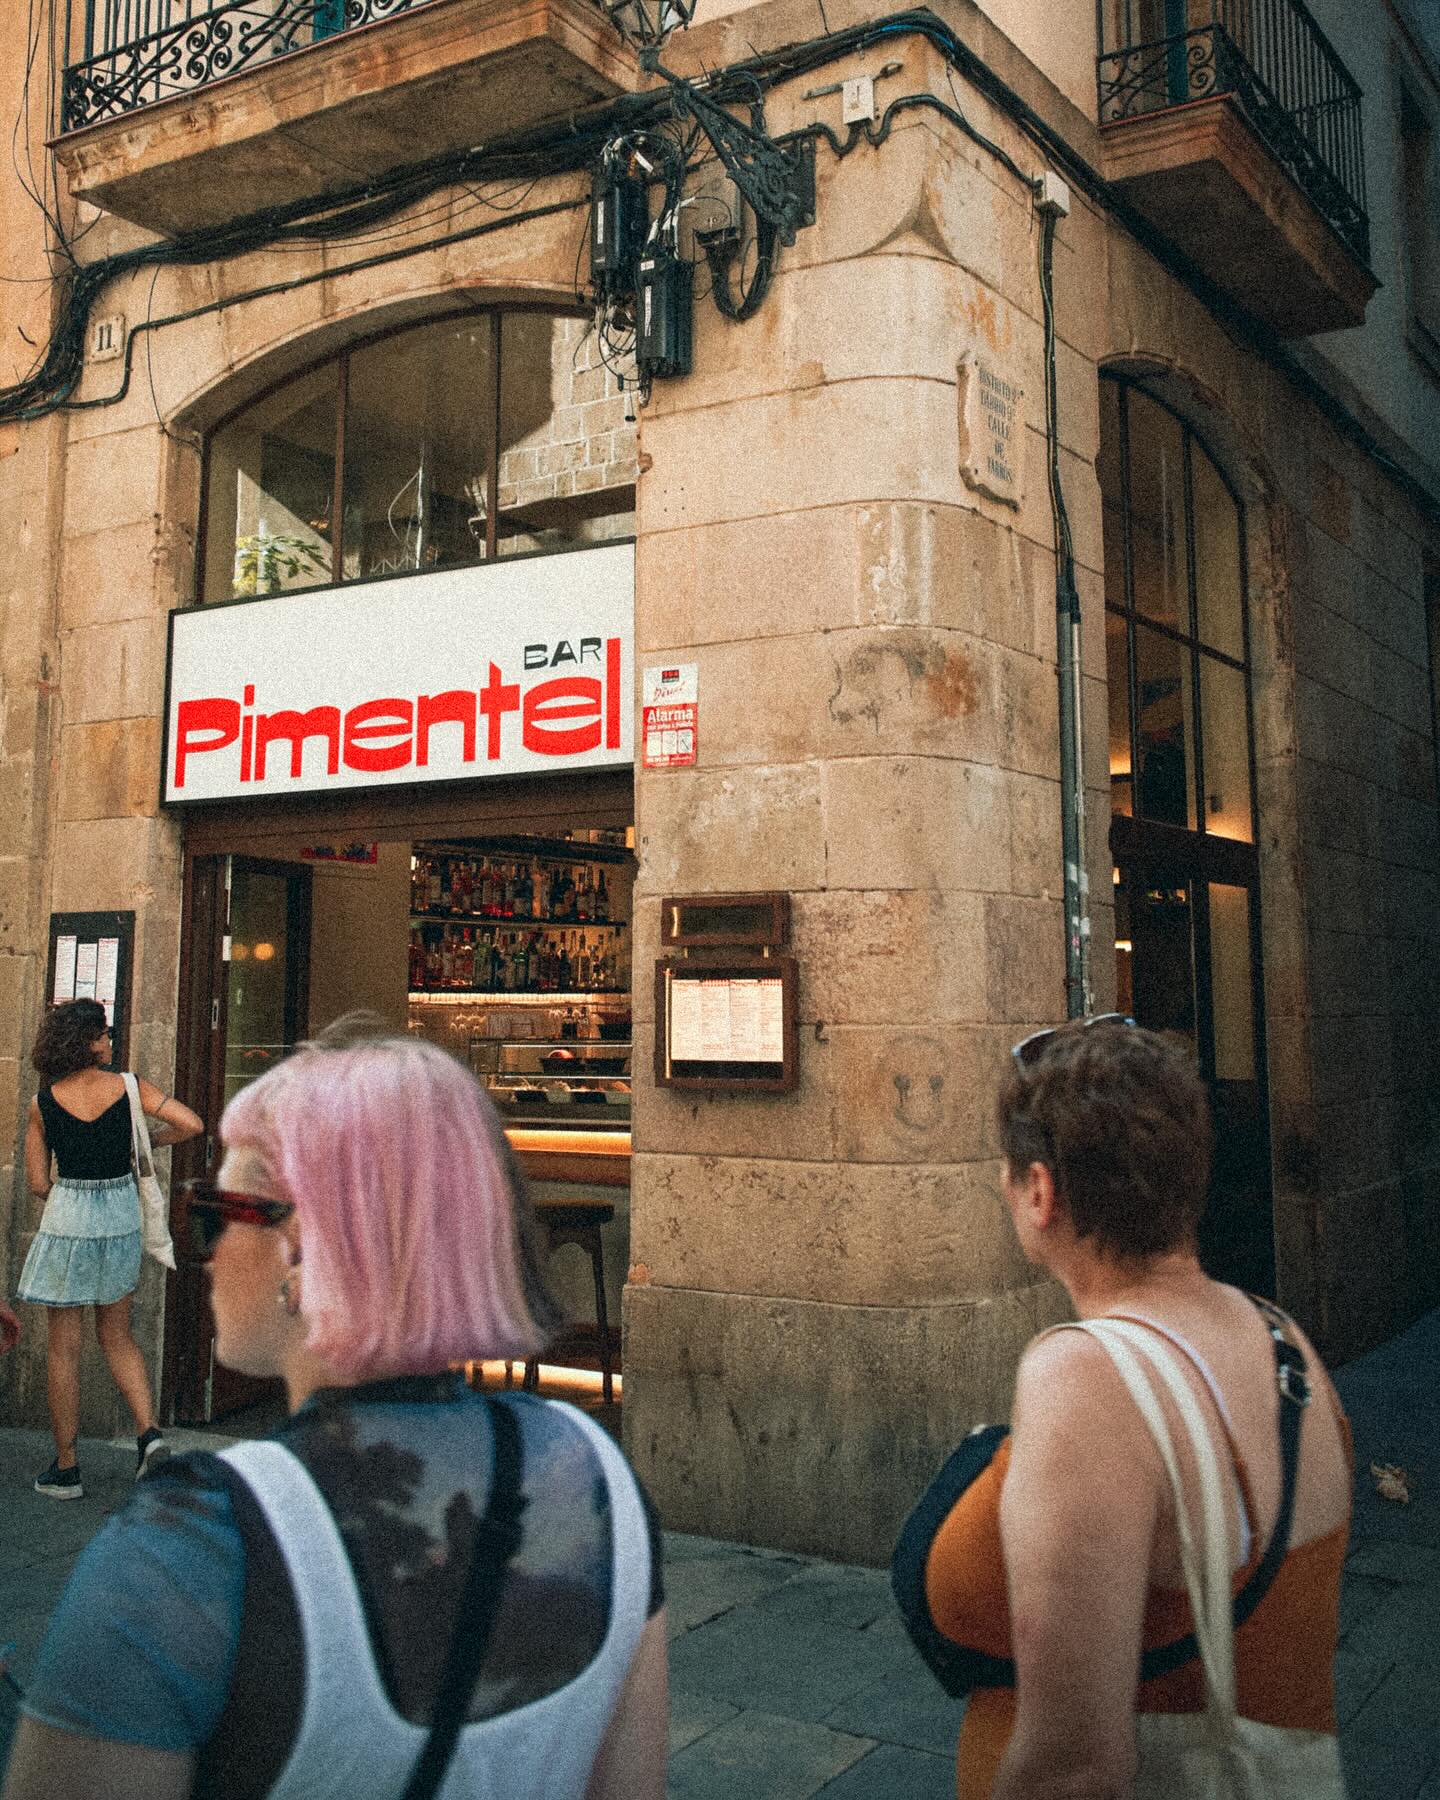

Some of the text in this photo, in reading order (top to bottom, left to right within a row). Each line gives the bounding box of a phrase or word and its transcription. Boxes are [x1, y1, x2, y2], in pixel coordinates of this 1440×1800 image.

[988, 414, 1010, 440] CALLE
[523, 637, 602, 670] BAR
[174, 637, 621, 788] Pimentel
[647, 708, 693, 723] Alarma
